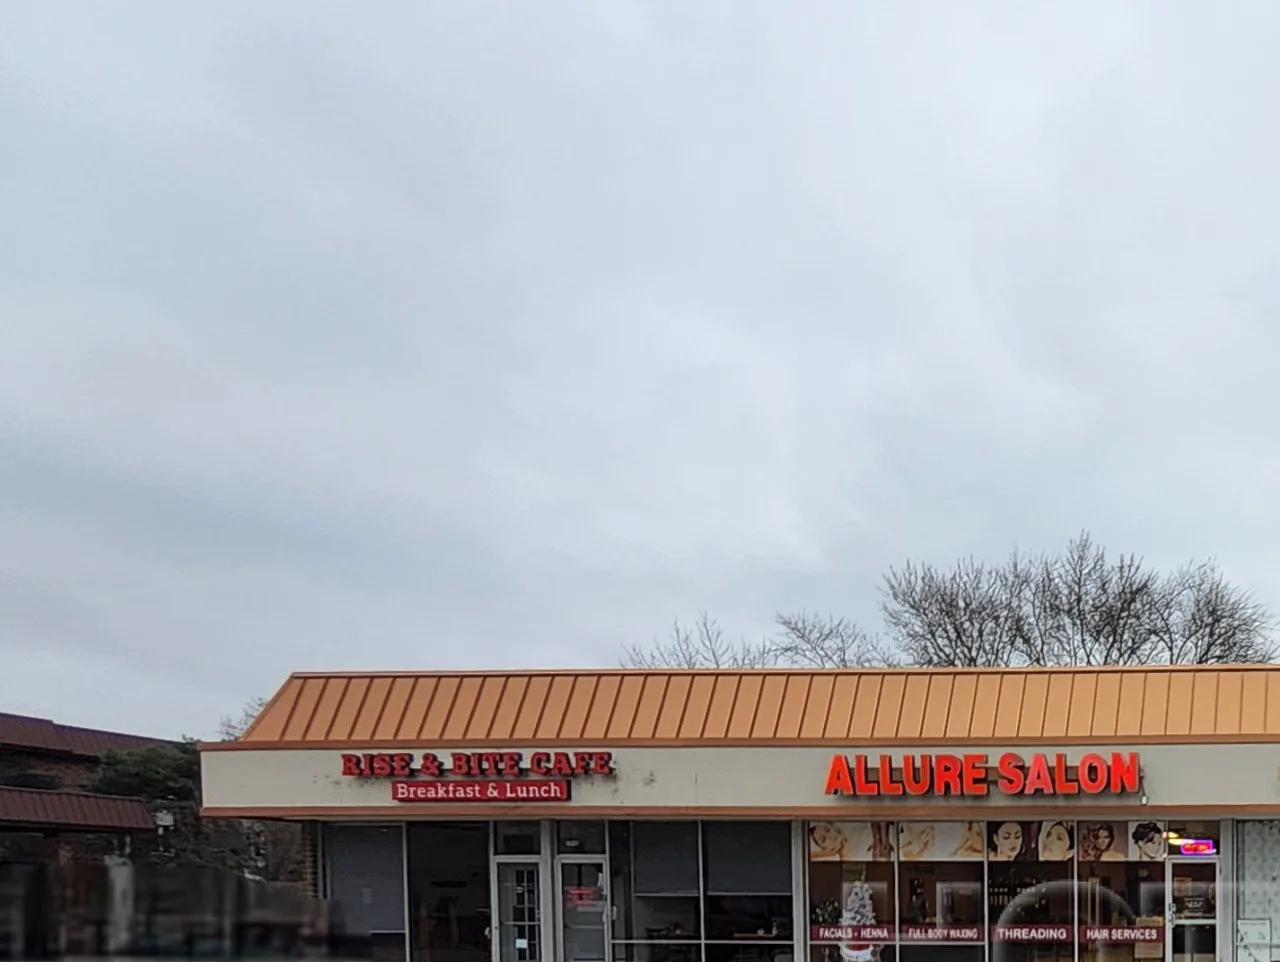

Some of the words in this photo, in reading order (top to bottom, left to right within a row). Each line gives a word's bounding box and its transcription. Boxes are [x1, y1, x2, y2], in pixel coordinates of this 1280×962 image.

[342, 752, 412, 777] RISE
[420, 753, 443, 776] &
[450, 752, 521, 776] BITE
[530, 751, 613, 776] CAFE
[825, 753, 988, 796] ALLURE
[998, 752, 1141, 796] SALON
[397, 783, 481, 798] Breakfast
[487, 783, 498, 797] &
[506, 782, 561, 798] Lunch
[819, 928, 853, 938] FACIALS
[861, 928, 888, 938] HENNA
[909, 928, 927, 938] FULL
[928, 928, 948, 938] BODY
[949, 928, 978, 939] WAXING
[999, 928, 1067, 939] THREADING
[1086, 929, 1109, 939] HAIR
[1111, 929, 1158, 939] SERVICES
